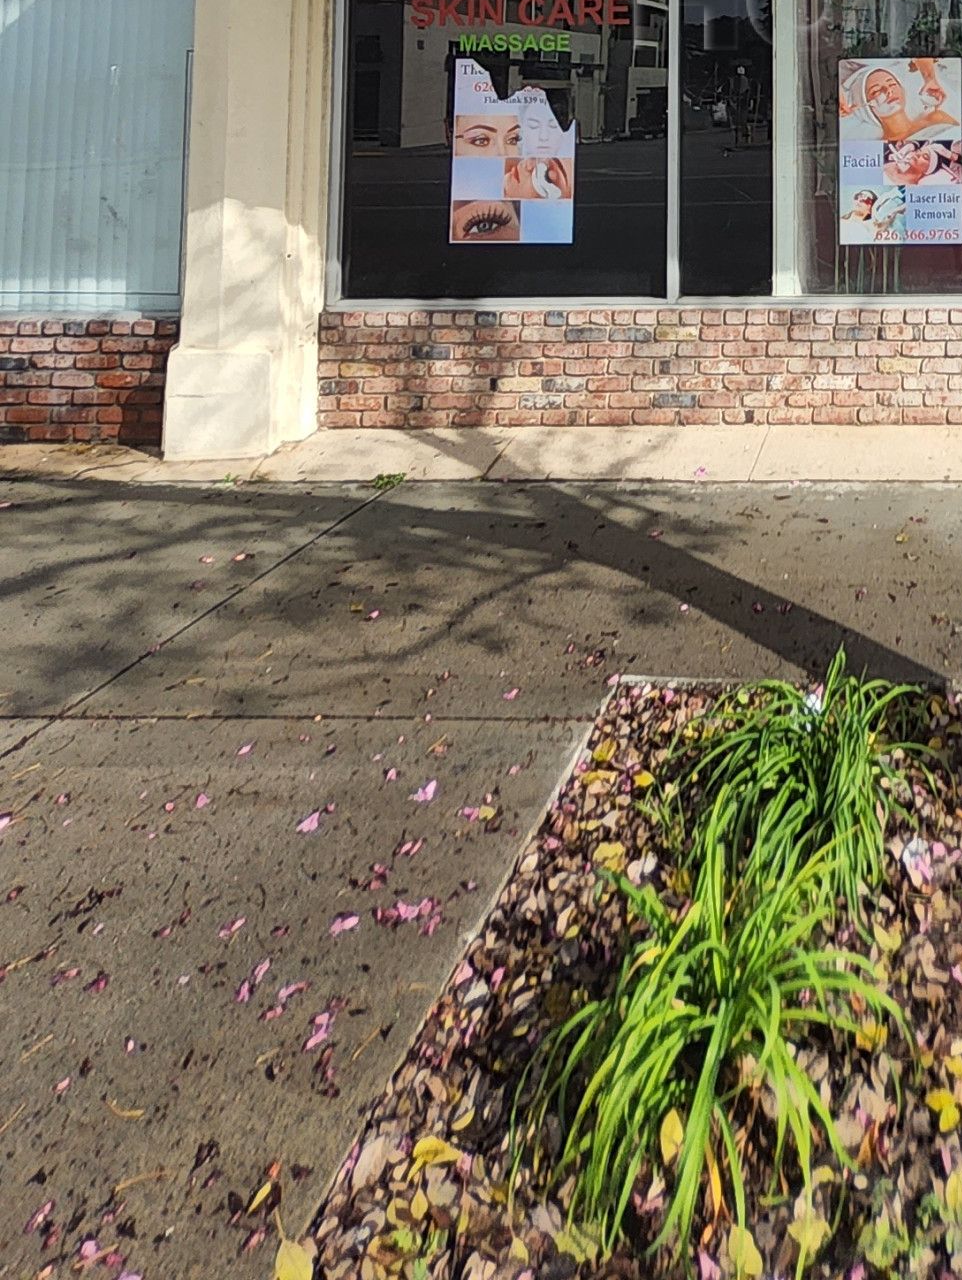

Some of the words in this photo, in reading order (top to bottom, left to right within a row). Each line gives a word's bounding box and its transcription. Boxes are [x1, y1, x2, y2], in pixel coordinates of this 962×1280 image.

[459, 33, 571, 52] MASSAGE
[843, 154, 881, 168] Facial
[909, 193, 936, 204] Laser
[938, 193, 960, 204] Hair
[914, 208, 956, 220] Removal
